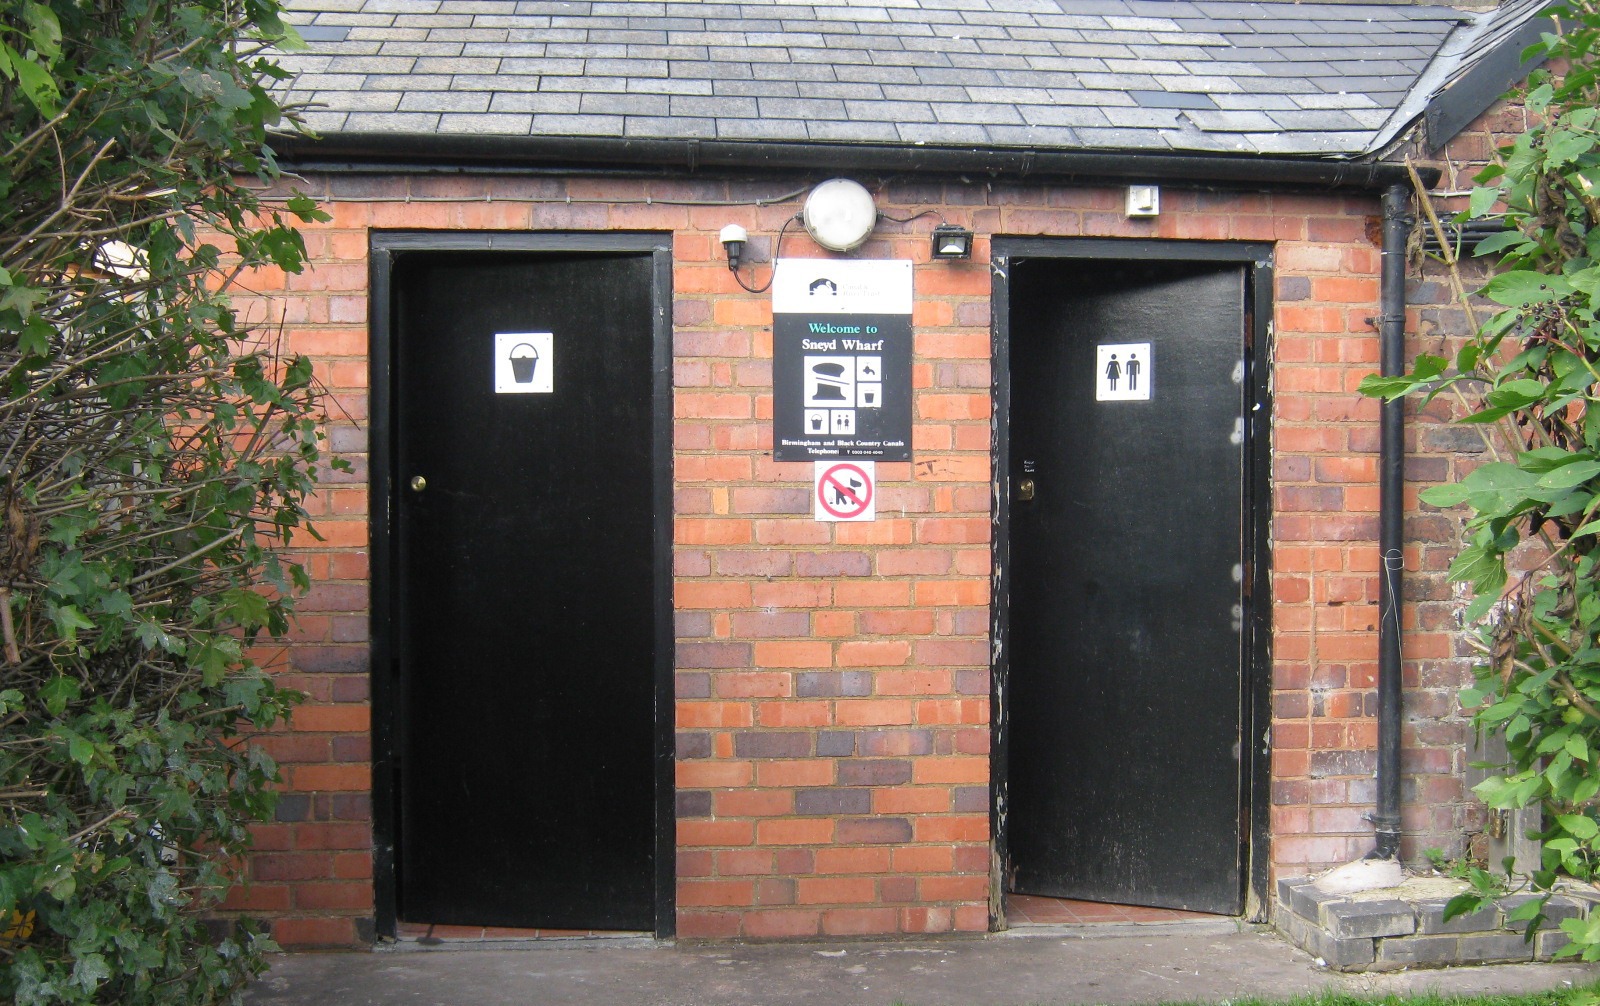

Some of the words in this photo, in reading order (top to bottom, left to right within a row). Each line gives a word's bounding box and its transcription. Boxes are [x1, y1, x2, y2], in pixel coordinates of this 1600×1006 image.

[808, 323, 861, 334] Welcome
[866, 324, 878, 334] to
[802, 338, 837, 352] Sneyd
[841, 339, 884, 351] Wharf
[781, 439, 821, 447] Birmingham
[837, 439, 855, 447] Black
[856, 440, 882, 448] Country
